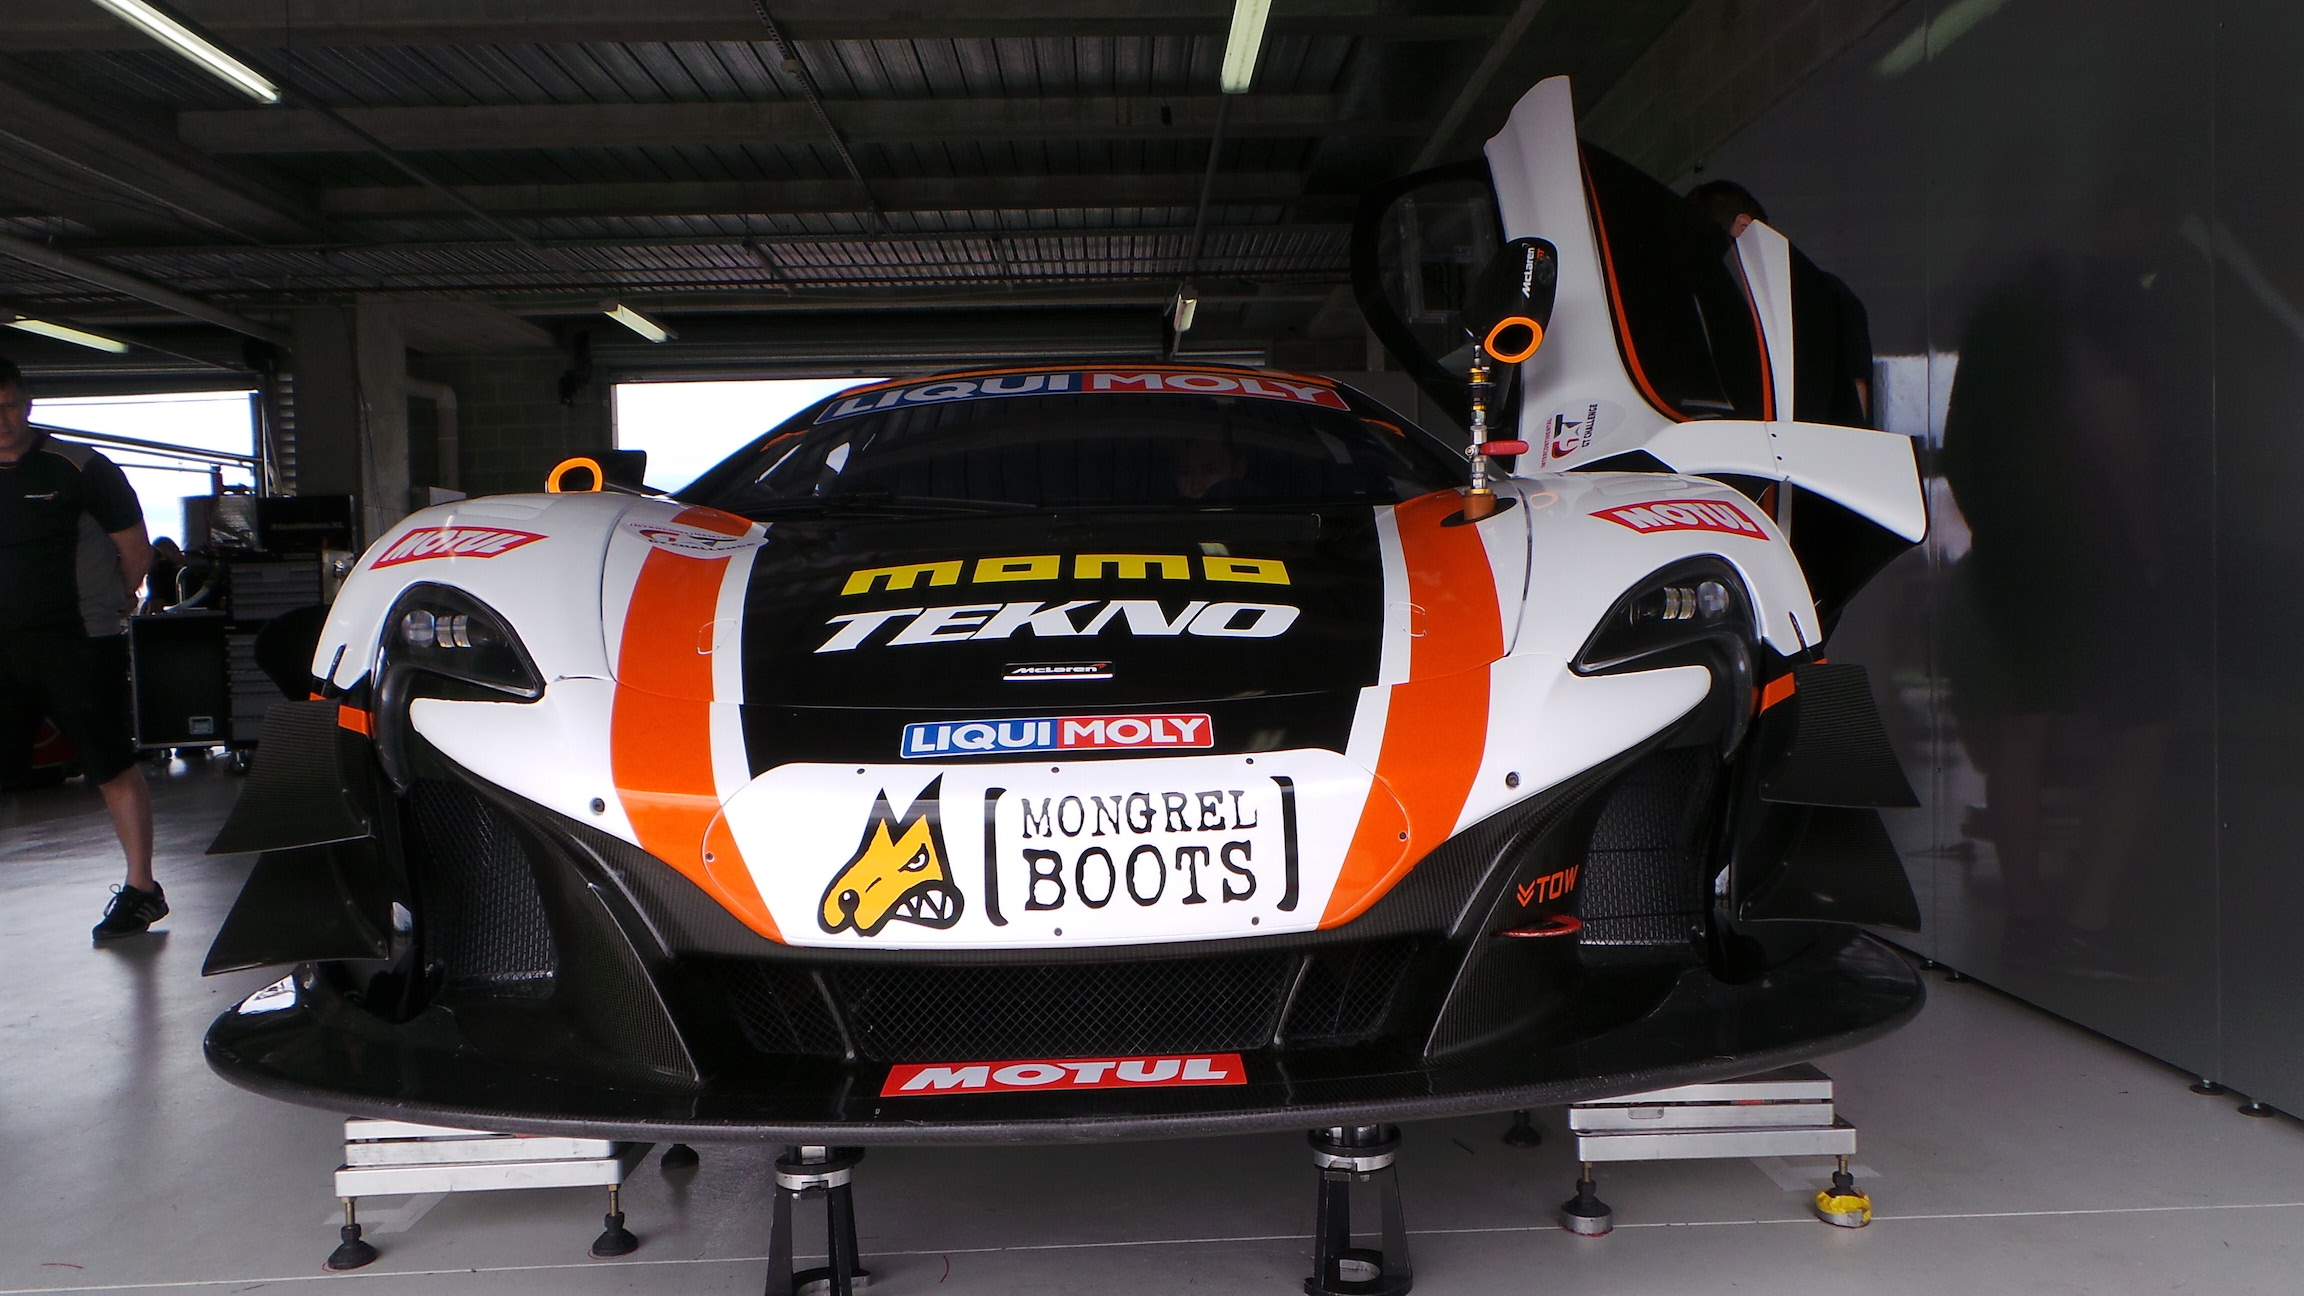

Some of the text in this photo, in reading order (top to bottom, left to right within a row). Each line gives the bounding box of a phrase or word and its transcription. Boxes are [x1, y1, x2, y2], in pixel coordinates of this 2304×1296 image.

[1522, 247, 1536, 299] McLaren
[832, 373, 1334, 417] LIQUI MOLY
[1583, 403, 1599, 439] CHALLENGE
[1611, 502, 1758, 533] MOTUL
[380, 529, 528, 562] MOTUL
[813, 600, 1301, 653] TEKNO
[1011, 666, 1098, 674] McLaren
[910, 717, 1206, 752] LIQUI MOLY
[1020, 789, 1258, 839] MONGREL
[1021, 839, 1258, 912] BOOTS
[1536, 864, 1580, 904] TOW
[899, 1058, 1228, 1091] MOTUL
